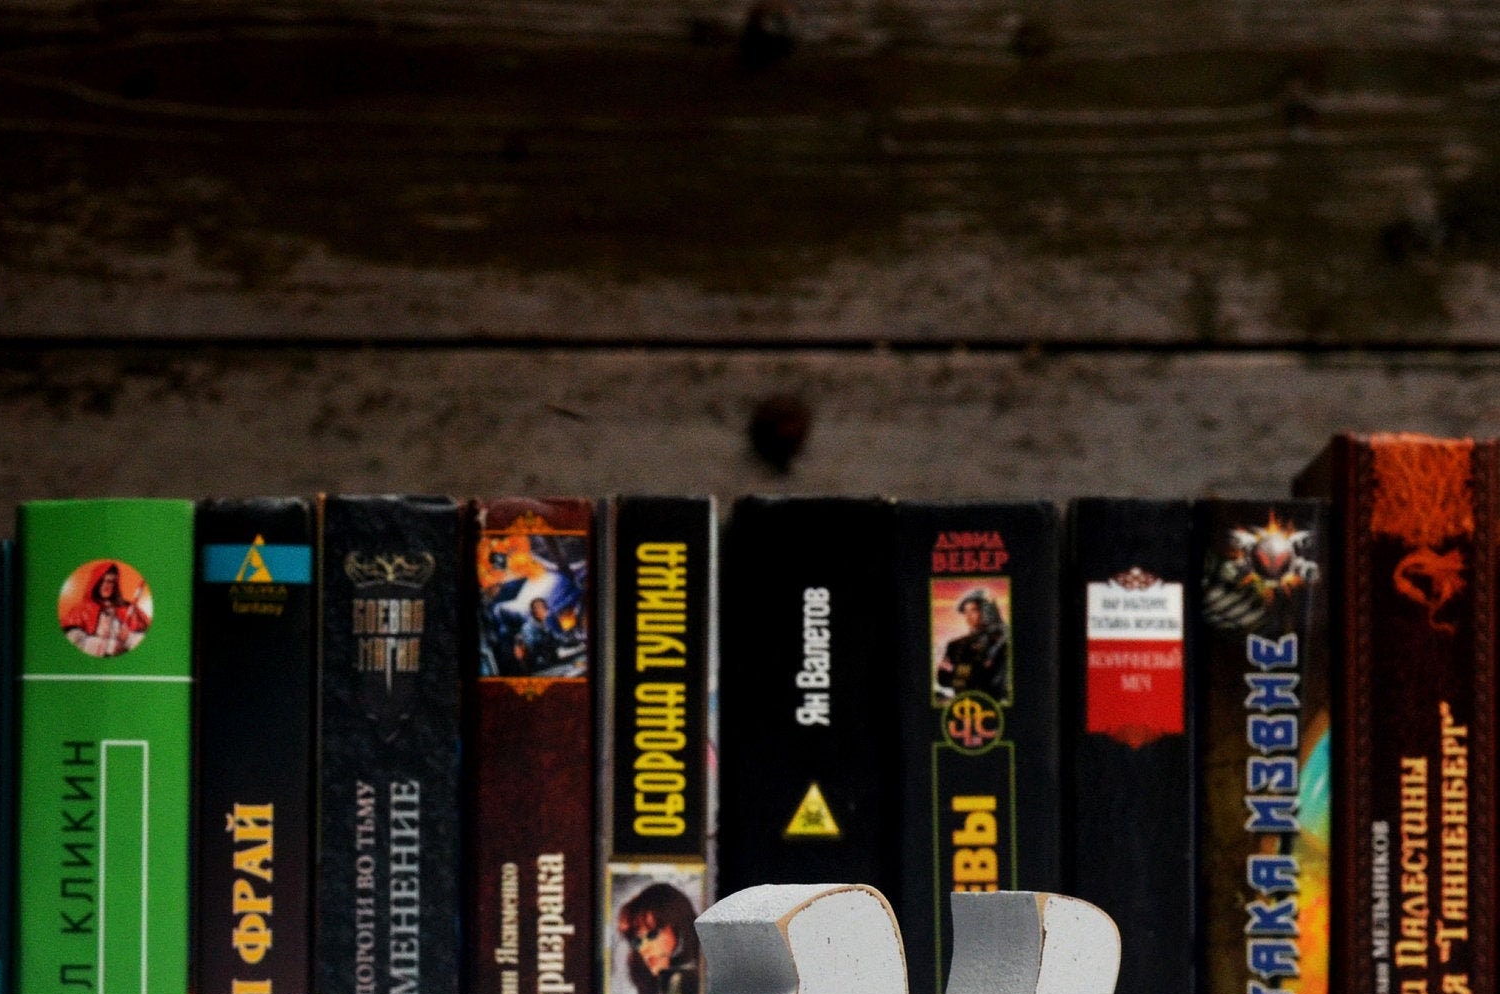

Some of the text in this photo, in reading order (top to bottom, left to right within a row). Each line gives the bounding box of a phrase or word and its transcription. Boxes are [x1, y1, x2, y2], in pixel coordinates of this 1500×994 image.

[932, 550, 1009, 572] ВЕБЕР
[634, 542, 687, 837] ОБОРОНА ТУПИКА
[795, 586, 830, 726] Ян Валетов
[1243, 631, 1300, 833] ИЗВНЕ
[59, 740, 95, 935] КЛИКИН
[226, 803, 273, 965] ФРАЙ
[355, 780, 376, 851] ТЬМУ
[355, 854, 376, 890] ВО
[951, 796, 999, 892] ВЫ
[1372, 820, 1390, 959] МЕЛЬНИКОВ
